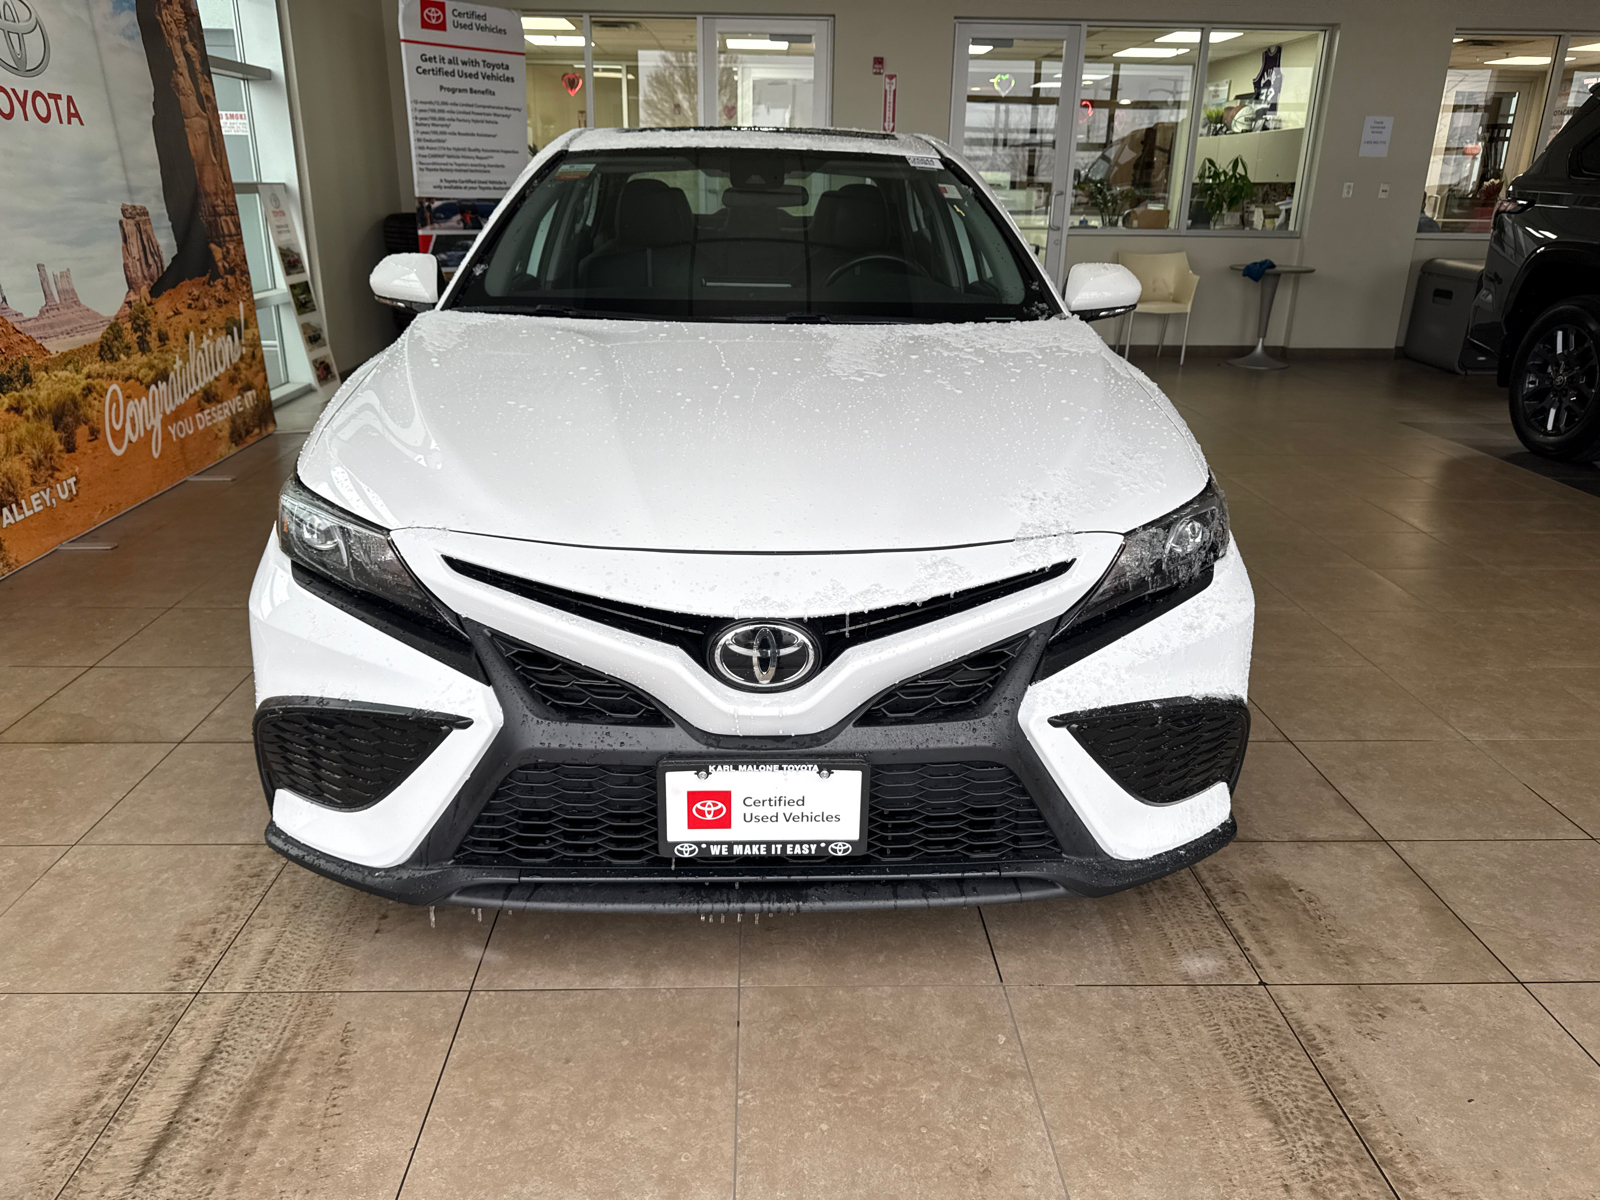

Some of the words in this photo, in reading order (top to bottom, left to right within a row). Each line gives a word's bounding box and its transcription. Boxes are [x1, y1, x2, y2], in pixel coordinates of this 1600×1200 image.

[452, 8, 487, 21] Certified
[452, 20, 473, 31] Used
[474, 23, 508, 35] Vehicles
[420, 53, 437, 64] Get
[439, 55, 446, 65] it
[447, 56, 459, 66] all
[460, 58, 480, 68] with
[481, 60, 510, 71] Toyota
[415, 66, 456, 78] Certified
[457, 69, 479, 80] Used
[480, 71, 515, 83] Vehicles
[439, 85, 468, 95] Program
[469, 87, 496, 96] Benefits
[0, 85, 85, 126] OYOTA
[104, 301, 247, 460] Congratulations!
[168, 416, 194, 442] YOU
[195, 395, 244, 430] DESERVE
[244, 389, 258, 409] IT!
[2, 487, 57, 529] ALLEY,
[56, 476, 77, 500] UT
[708, 764, 736, 772] KARL
[738, 764, 780, 772] MALONE
[781, 764, 820, 772] TOYOTA
[742, 795, 805, 807] Certified
[743, 811, 779, 823] Used
[782, 811, 841, 823] Vehicles
[709, 844, 729, 855] WE
[733, 844, 767, 855] MAKE
[771, 844, 782, 855] IT
[786, 843, 817, 855] EASY
